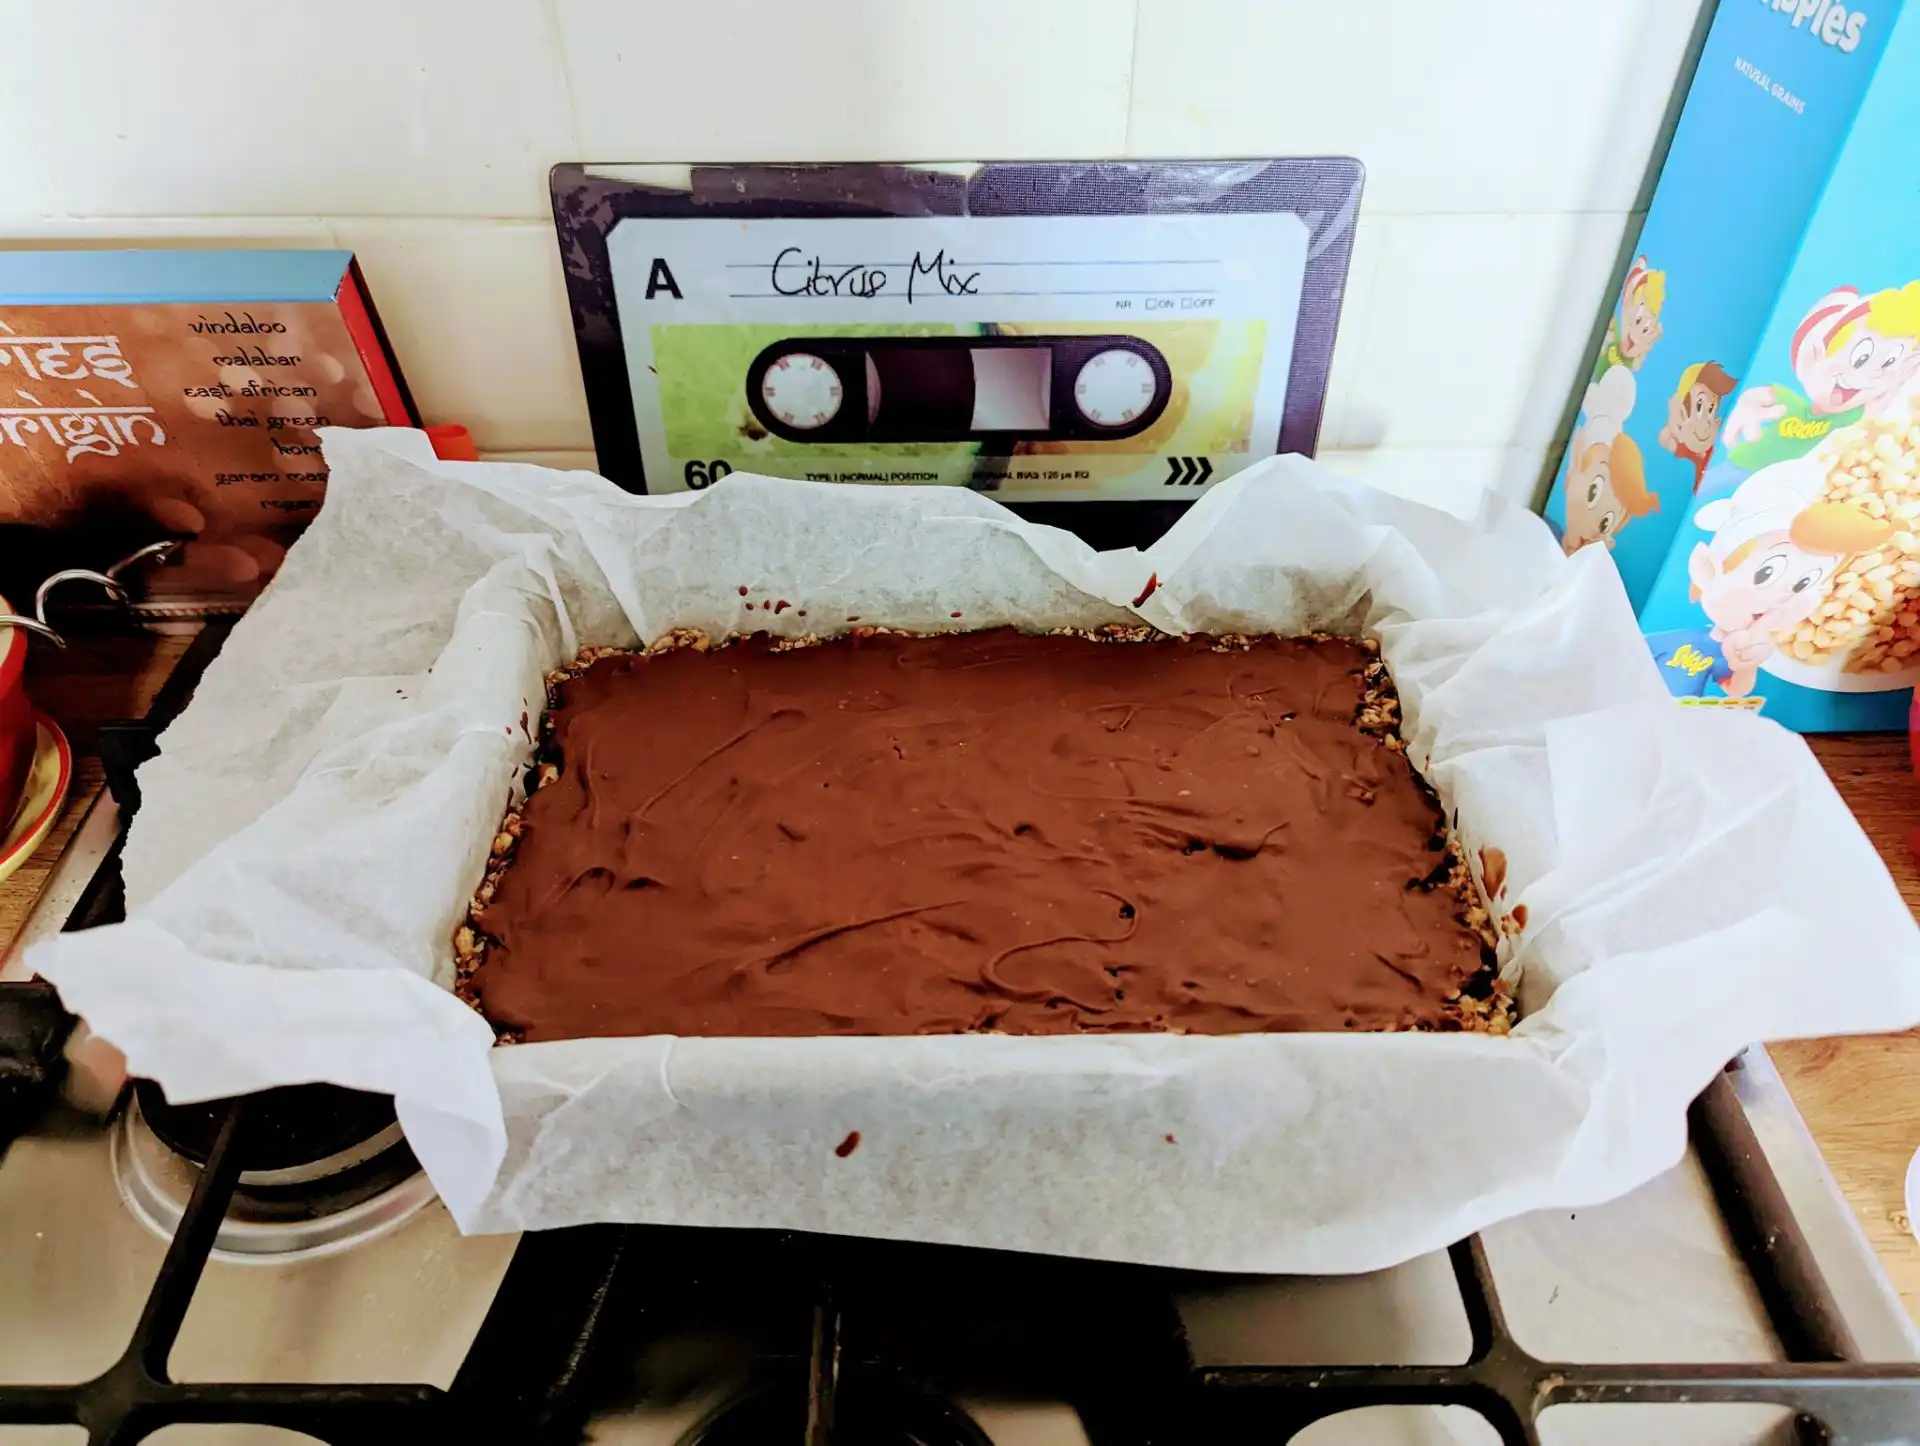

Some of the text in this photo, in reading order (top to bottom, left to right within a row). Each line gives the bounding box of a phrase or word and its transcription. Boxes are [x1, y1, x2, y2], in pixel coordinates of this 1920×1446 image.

[1759, 0, 1867, 53] pies
[1734, 56, 1806, 115] NATURAL GRAINS
[645, 258, 684, 299] A
[772, 247, 980, 304] Citrus Mix
[1158, 299, 1175, 309] ON
[1193, 298, 1216, 308] OFF
[188, 312, 287, 334] vindaloo
[212, 345, 302, 366] malabar
[184, 380, 317, 399] east african
[0, 389, 165, 464] rigin
[215, 408, 331, 430] thai green
[214, 473, 280, 487] garam
[684, 460, 732, 490] 60
[805, 473, 831, 481] TYPE
[890, 472, 938, 481] POSITION
